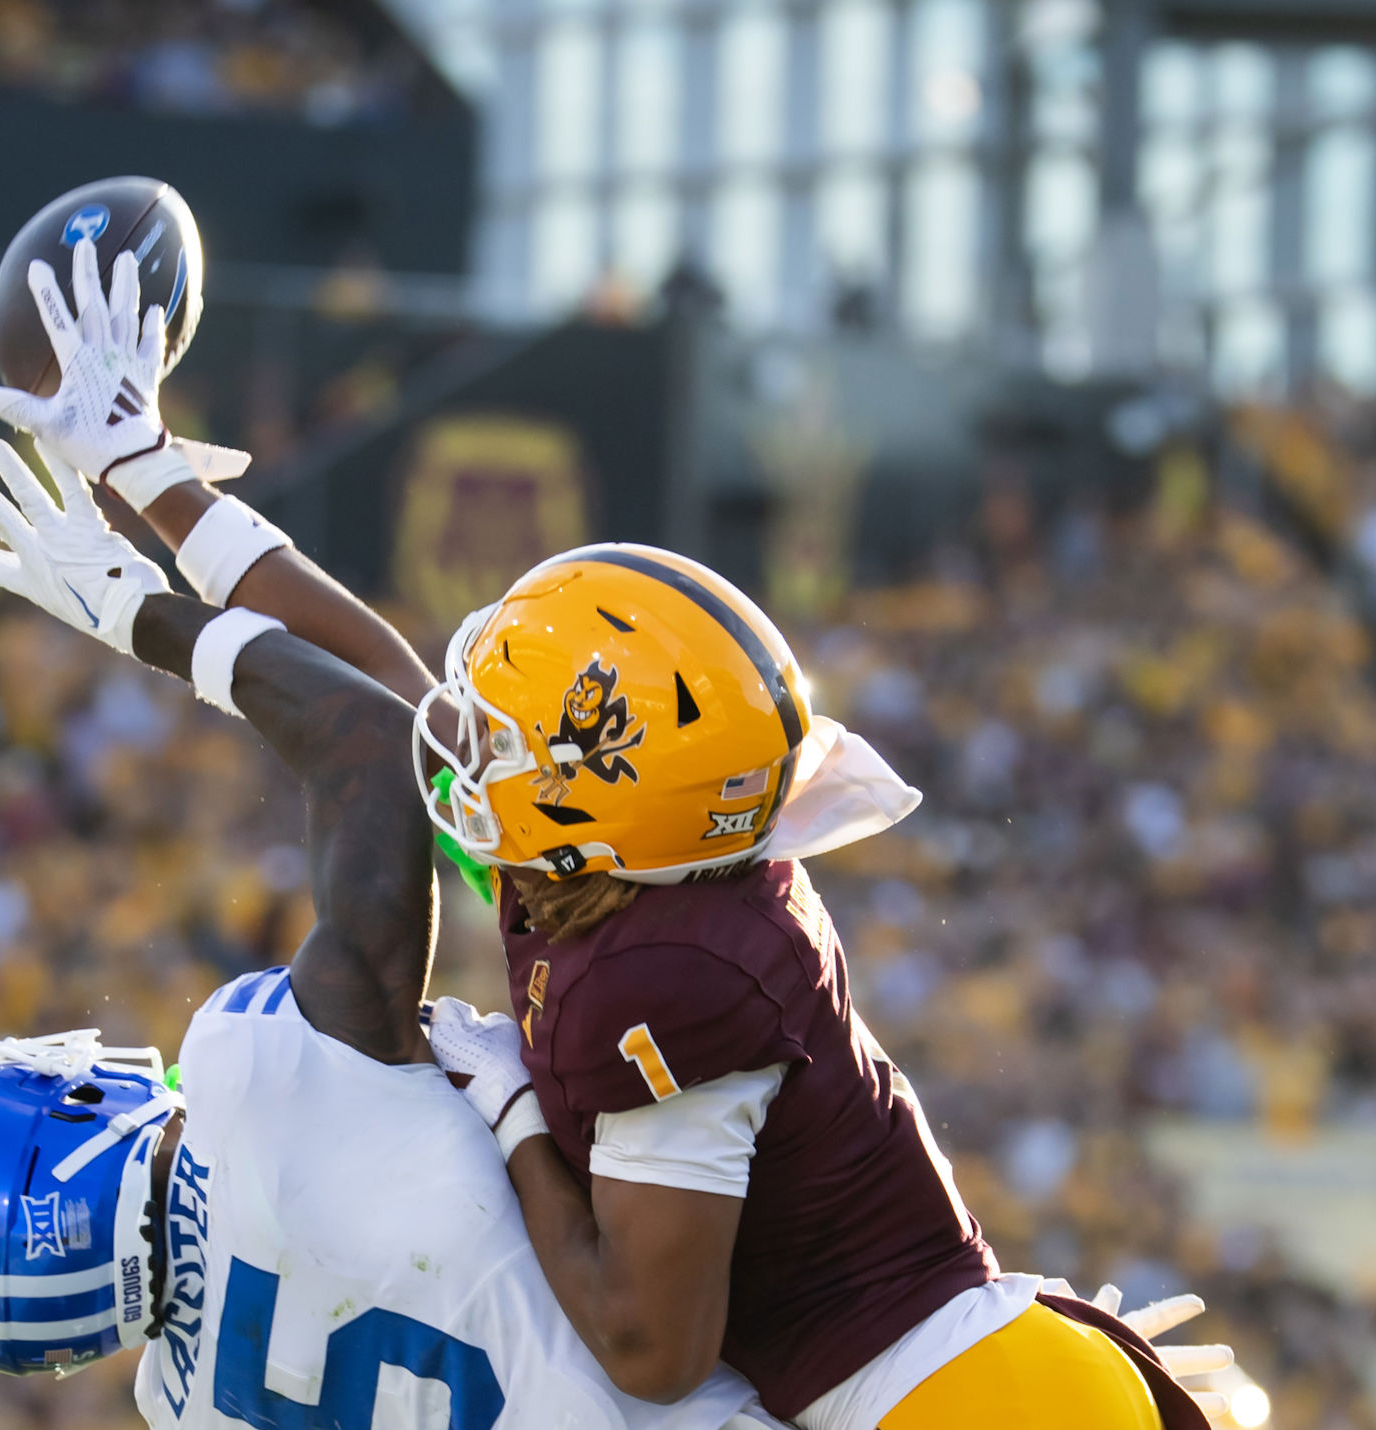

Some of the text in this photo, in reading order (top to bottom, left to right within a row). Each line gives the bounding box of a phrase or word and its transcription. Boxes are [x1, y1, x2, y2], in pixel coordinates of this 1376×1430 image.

[700, 805, 762, 840] XII
[617, 1022, 683, 1103] 1
[121, 1256, 142, 1323] GO COUGS
